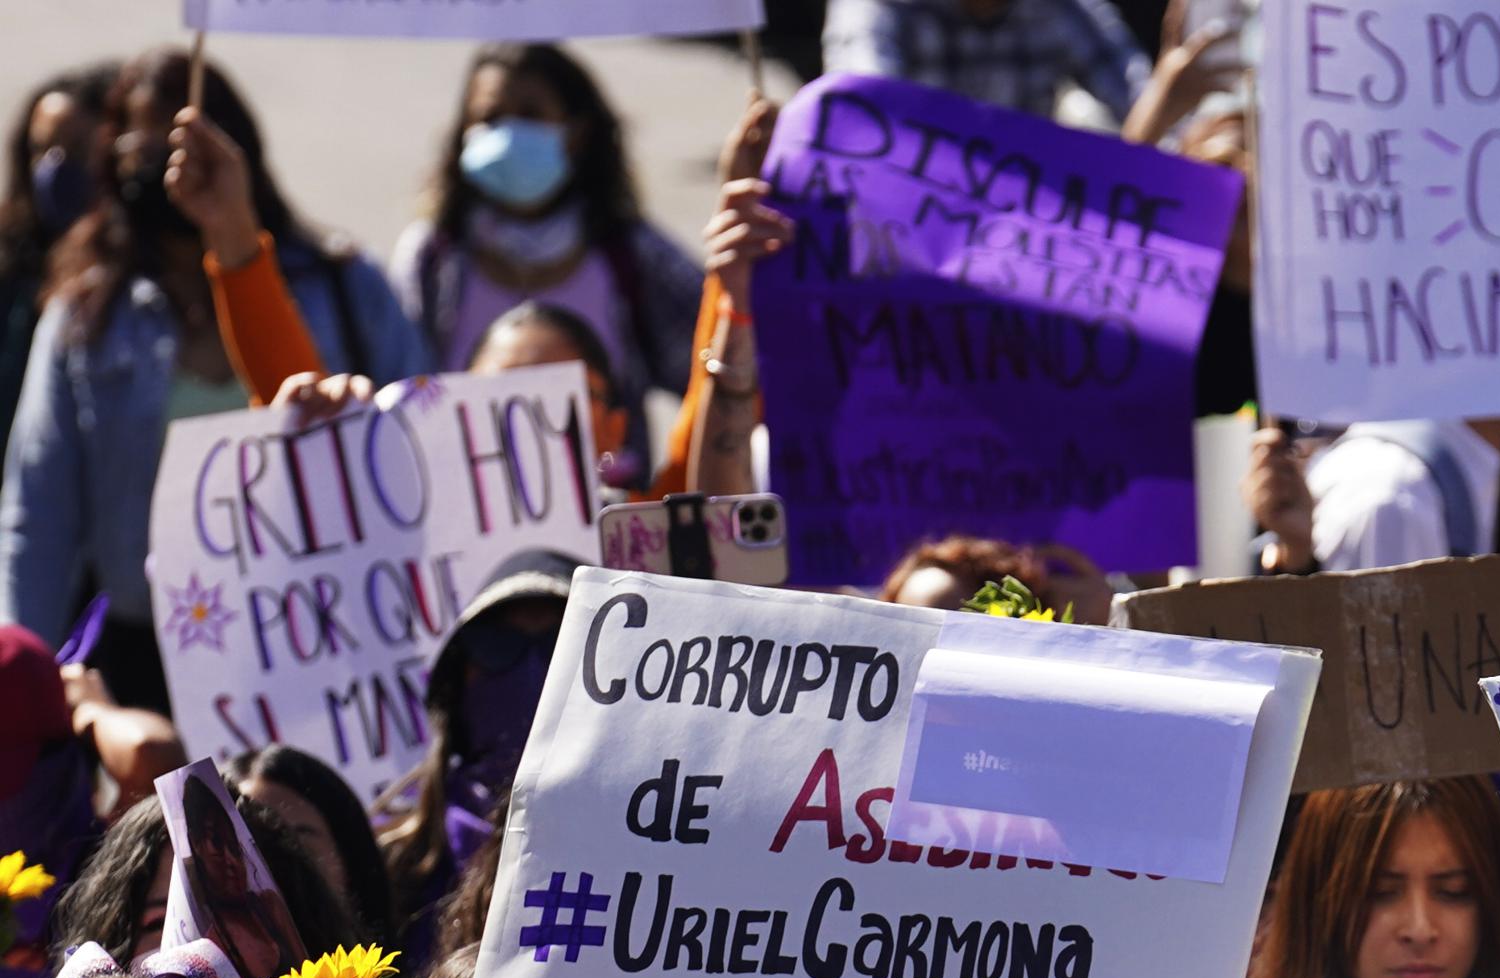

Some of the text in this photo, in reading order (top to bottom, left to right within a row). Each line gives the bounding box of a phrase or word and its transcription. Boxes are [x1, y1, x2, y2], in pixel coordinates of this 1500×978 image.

[1308, 2, 1408, 110] ES
[1302, 118, 1402, 191] QUE
[1314, 190, 1406, 242] HOY
[194, 392, 594, 574] GRITO HOY
[249, 573, 358, 672] POR
